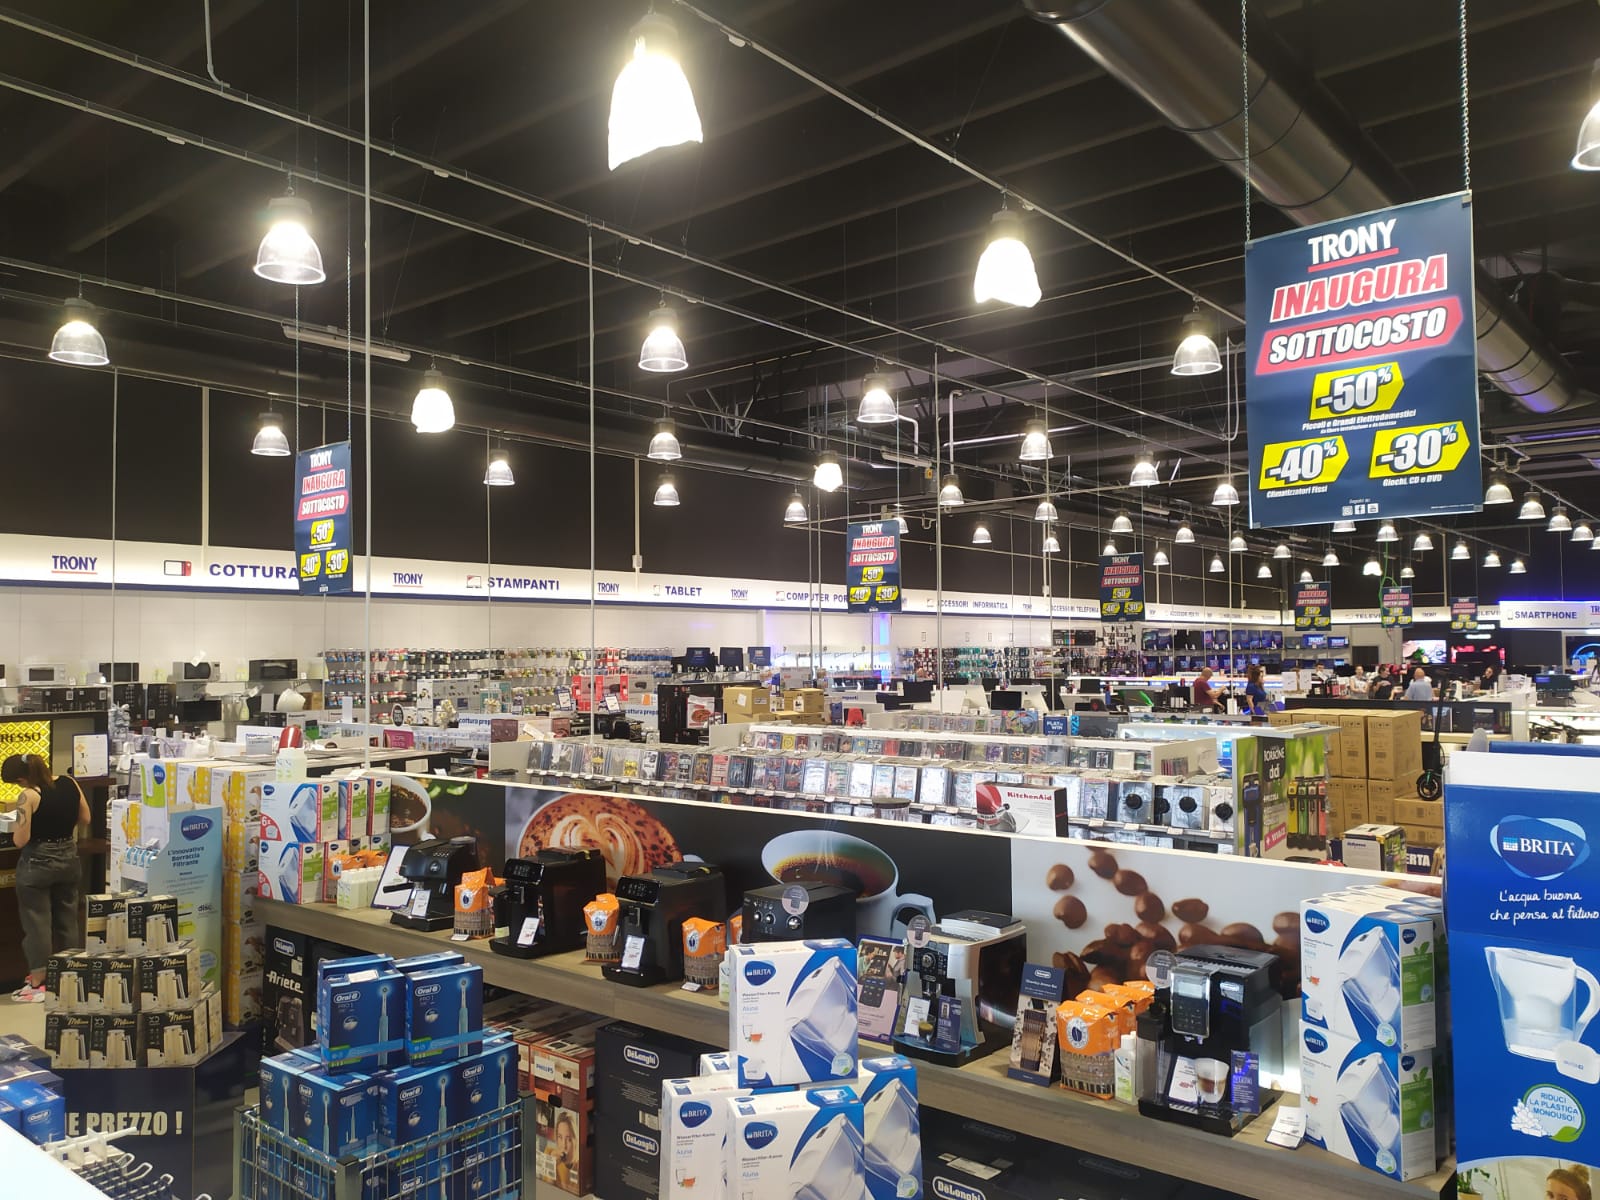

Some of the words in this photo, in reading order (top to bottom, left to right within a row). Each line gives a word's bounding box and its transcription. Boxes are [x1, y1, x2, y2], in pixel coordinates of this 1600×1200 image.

[1308, 219, 1396, 264] TRONY
[1270, 254, 1447, 323] INAUGURA
[1269, 307, 1446, 364] SOTTOCOSTO
[1320, 366, 1392, 412] -50%
[1302, 421, 1326, 431] Piccoli
[1333, 417, 1355, 427] Grandi
[1357, 409, 1417, 424] Elettrodomestici
[1380, 425, 1456, 470] -30%
[310, 450, 333, 468] TRONY
[1269, 440, 1337, 482] -40%
[302, 469, 345, 495] INAUGURA
[1408, 475, 1420, 485] CD
[1426, 474, 1443, 483] DVD
[1266, 486, 1311, 498] Climatizzatori
[1312, 484, 1328, 494] Fissi
[301, 495, 345, 515] SOTTOCOSTO
[862, 524, 883, 534] TRONY
[852, 536, 894, 550] INAUGURA
[51, 555, 98, 571] TRONY
[852, 552, 894, 562] SOTTOCOSTO
[209, 563, 297, 580] COTTURA
[393, 572, 423, 586] TRONY
[487, 576, 560, 591] STAMPANTI
[597, 582, 620, 593] TRONY
[665, 585, 702, 597] TABLET
[730, 589, 748, 599] TRONY
[786, 592, 829, 602] COMPUTER
[972, 601, 1008, 609] INFORMATICA
[1515, 611, 1577, 619] SMARTPHONE
[1007, 791, 1052, 801] KitchenAid
[189, 822, 208, 830] BRITA
[1520, 837, 1575, 857] BRITA
[1500, 889, 1540, 907] L'acqua
[1544, 888, 1582, 901] buona
[1490, 909, 1510, 921] che
[1513, 911, 1548, 926] pensa
[1552, 908, 1564, 919] al
[1567, 905, 1599, 919] futuro
[266, 970, 304, 994] Ariete
[1541, 1092, 1567, 1103] RIDUCI
[688, 1109, 707, 1117] BRITA
[1533, 1107, 1576, 1121] MONOUSO!
[1541, 1099, 1578, 1114] PLASTICA
[86, 1111, 168, 1136] PREZZO
[175, 1111, 183, 1135] !
